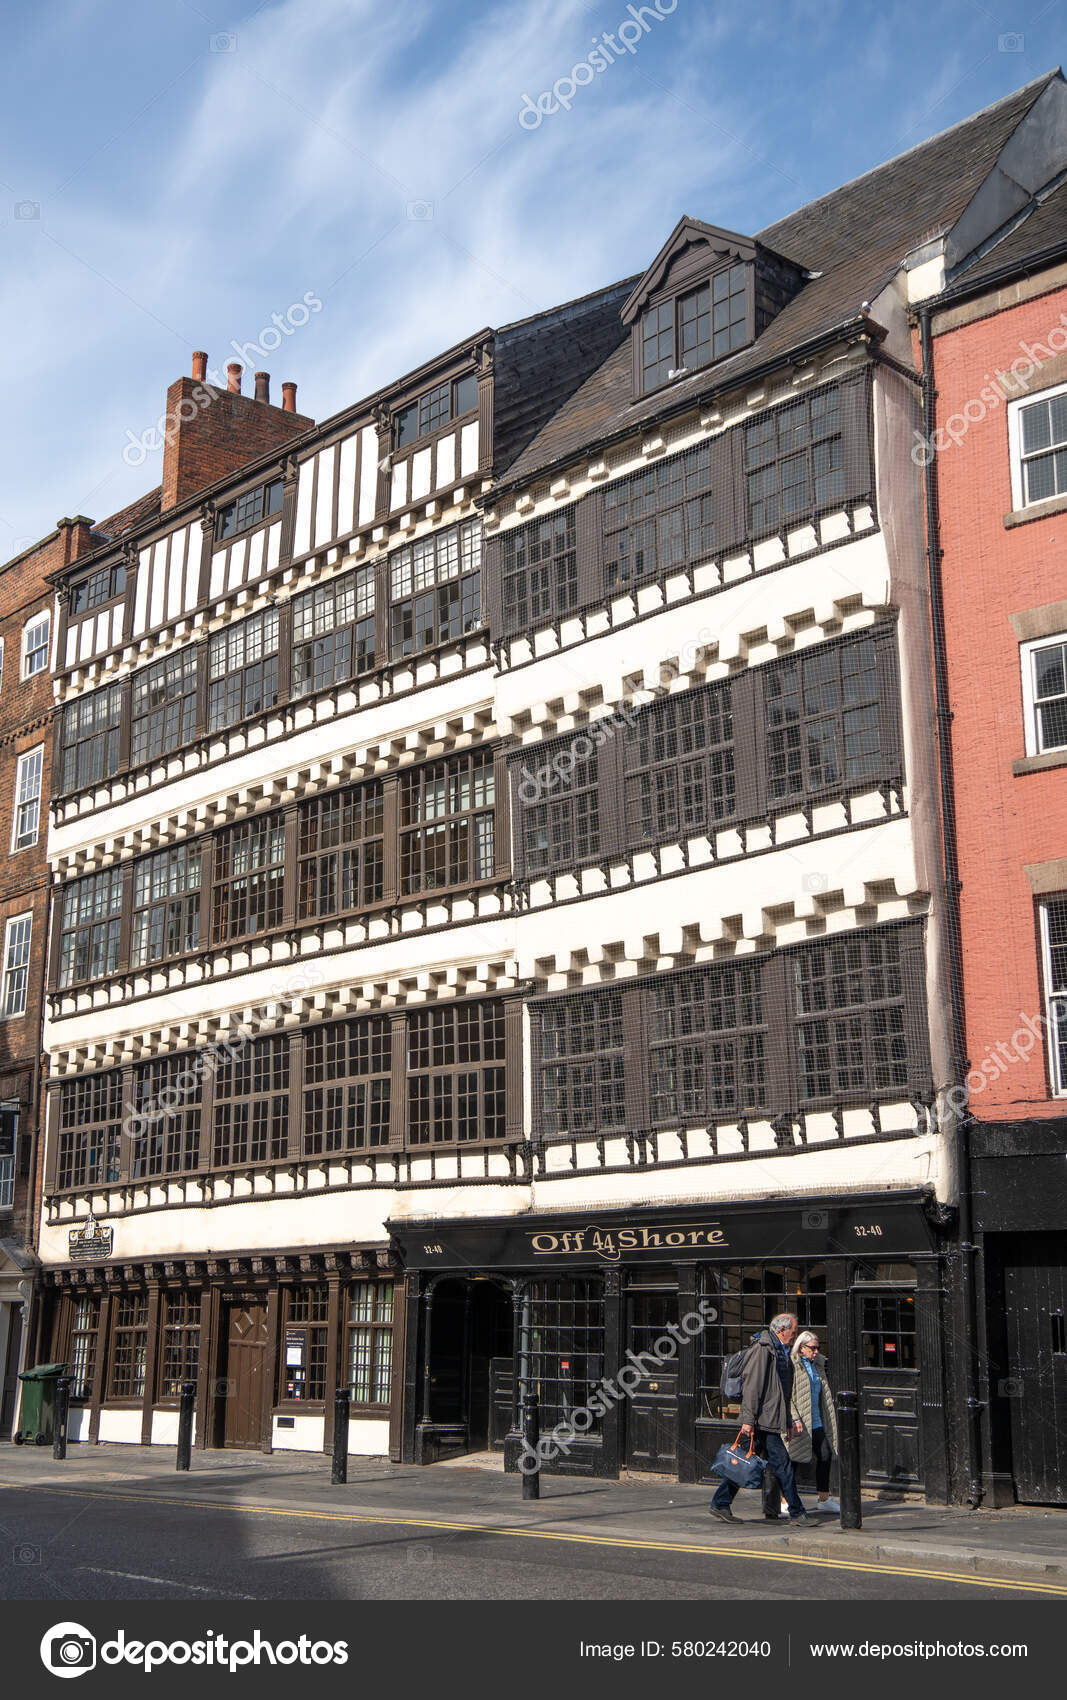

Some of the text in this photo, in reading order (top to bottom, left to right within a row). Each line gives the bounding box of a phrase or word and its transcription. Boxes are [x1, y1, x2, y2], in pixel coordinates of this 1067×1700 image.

[854, 1225, 883, 1236] 32-40
[532, 1228, 725, 1254] Off 44 Shore
